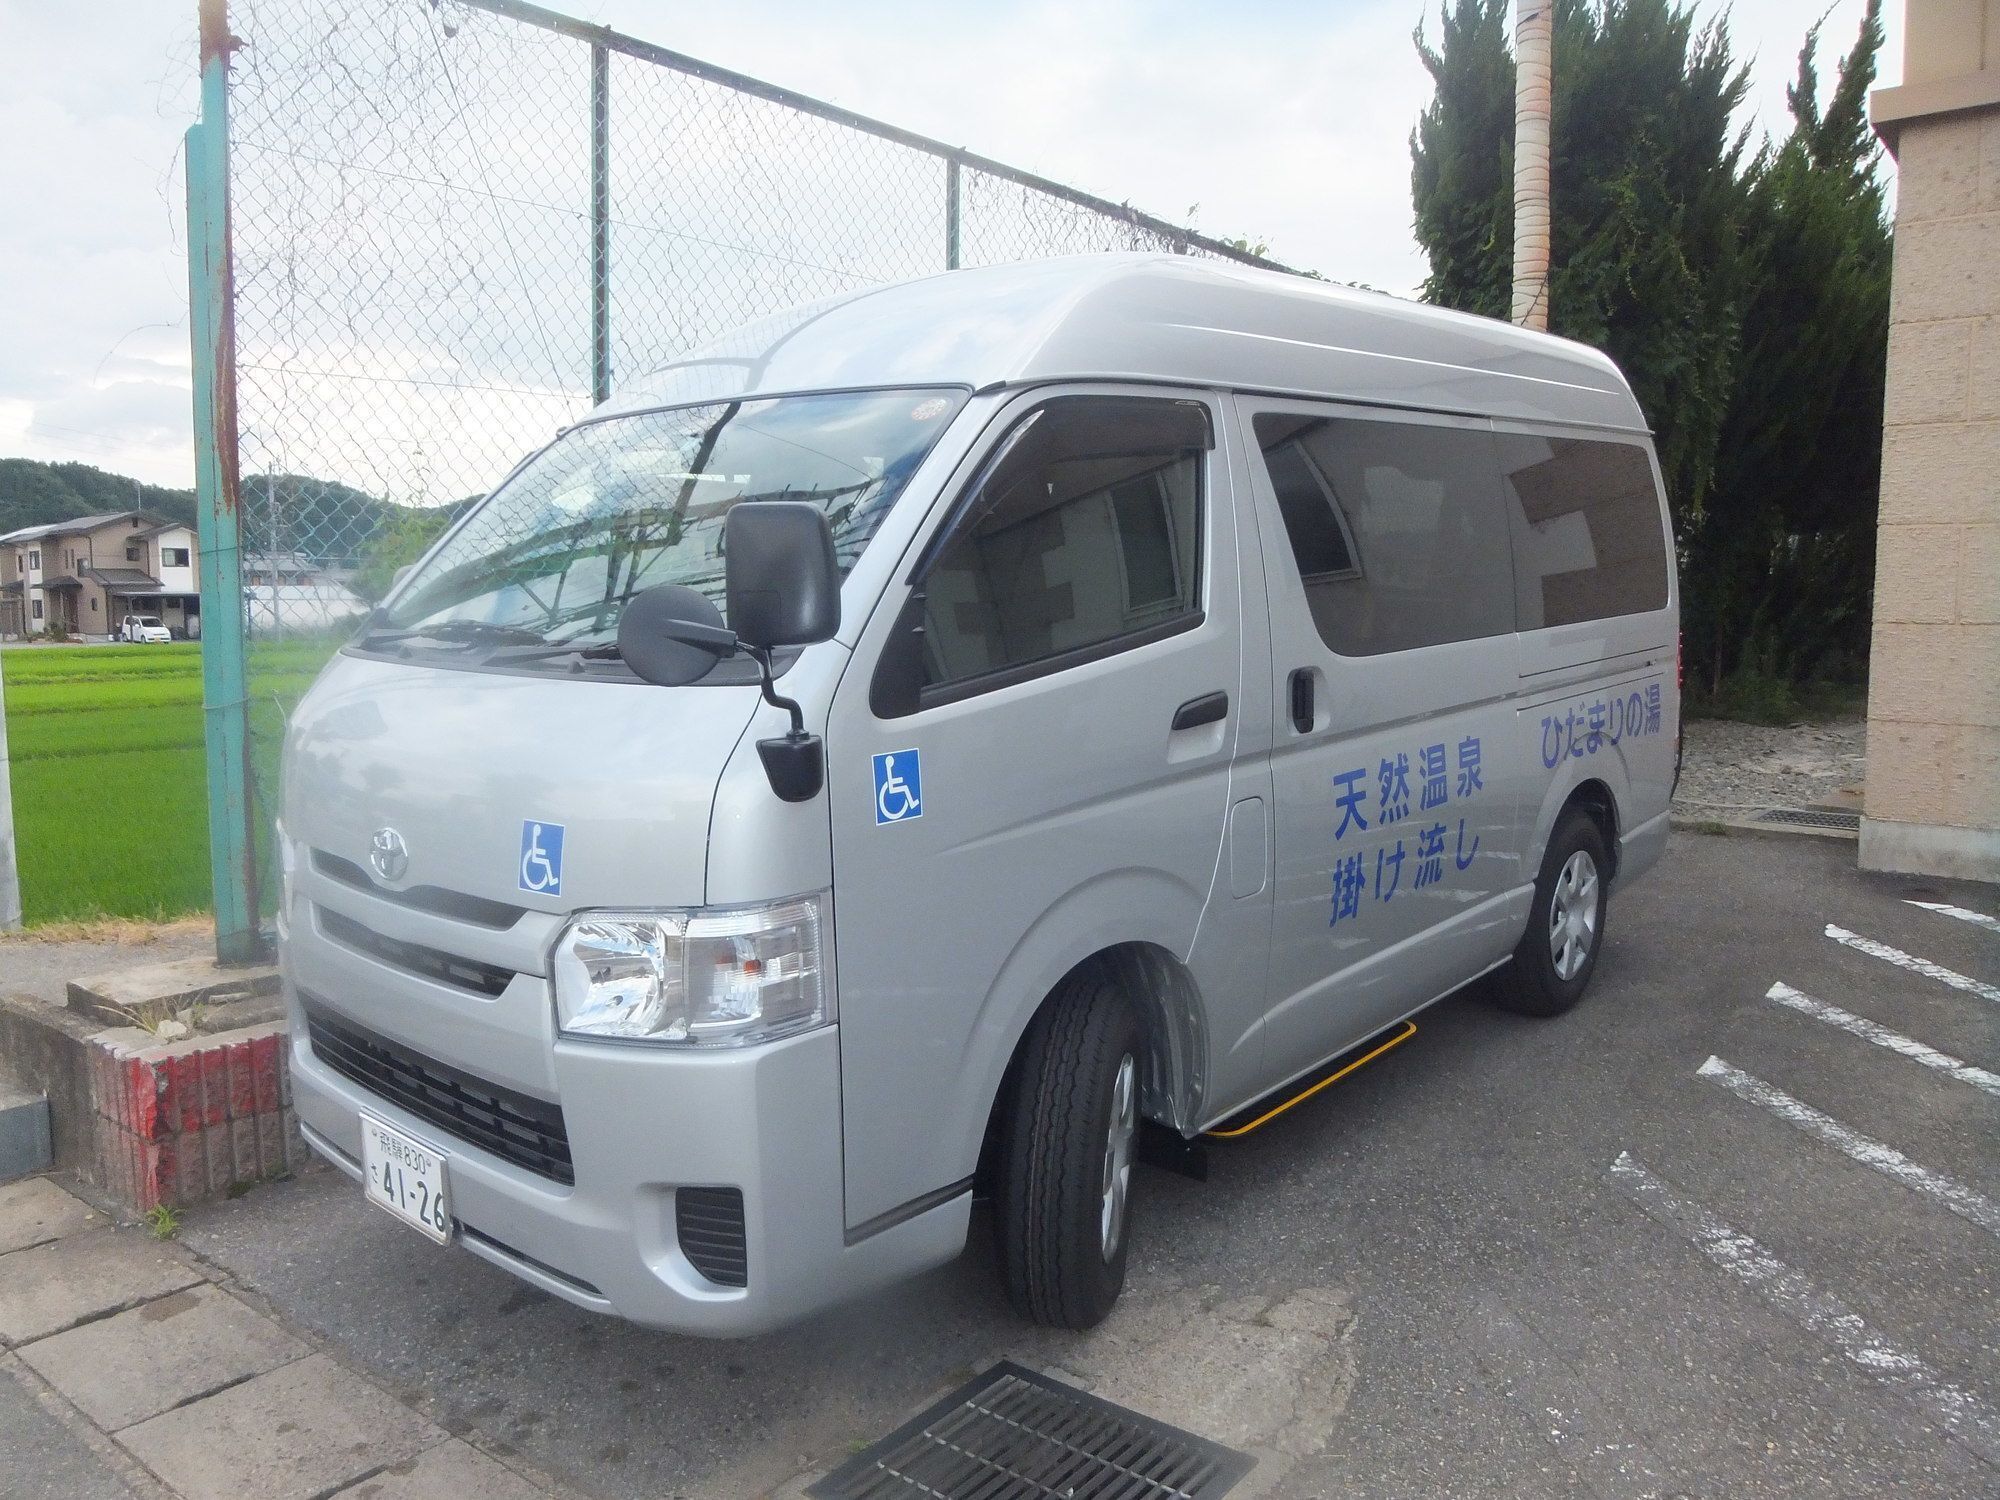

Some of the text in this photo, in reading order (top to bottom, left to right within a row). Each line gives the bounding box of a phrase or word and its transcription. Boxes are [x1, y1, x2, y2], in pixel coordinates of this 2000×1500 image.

[1541, 683, 1661, 769] ひだまりの湯
[1333, 735, 1483, 841] 天然温泉
[1329, 818, 1480, 928] 掛け流し
[384, 1161, 445, 1232] 41-26
